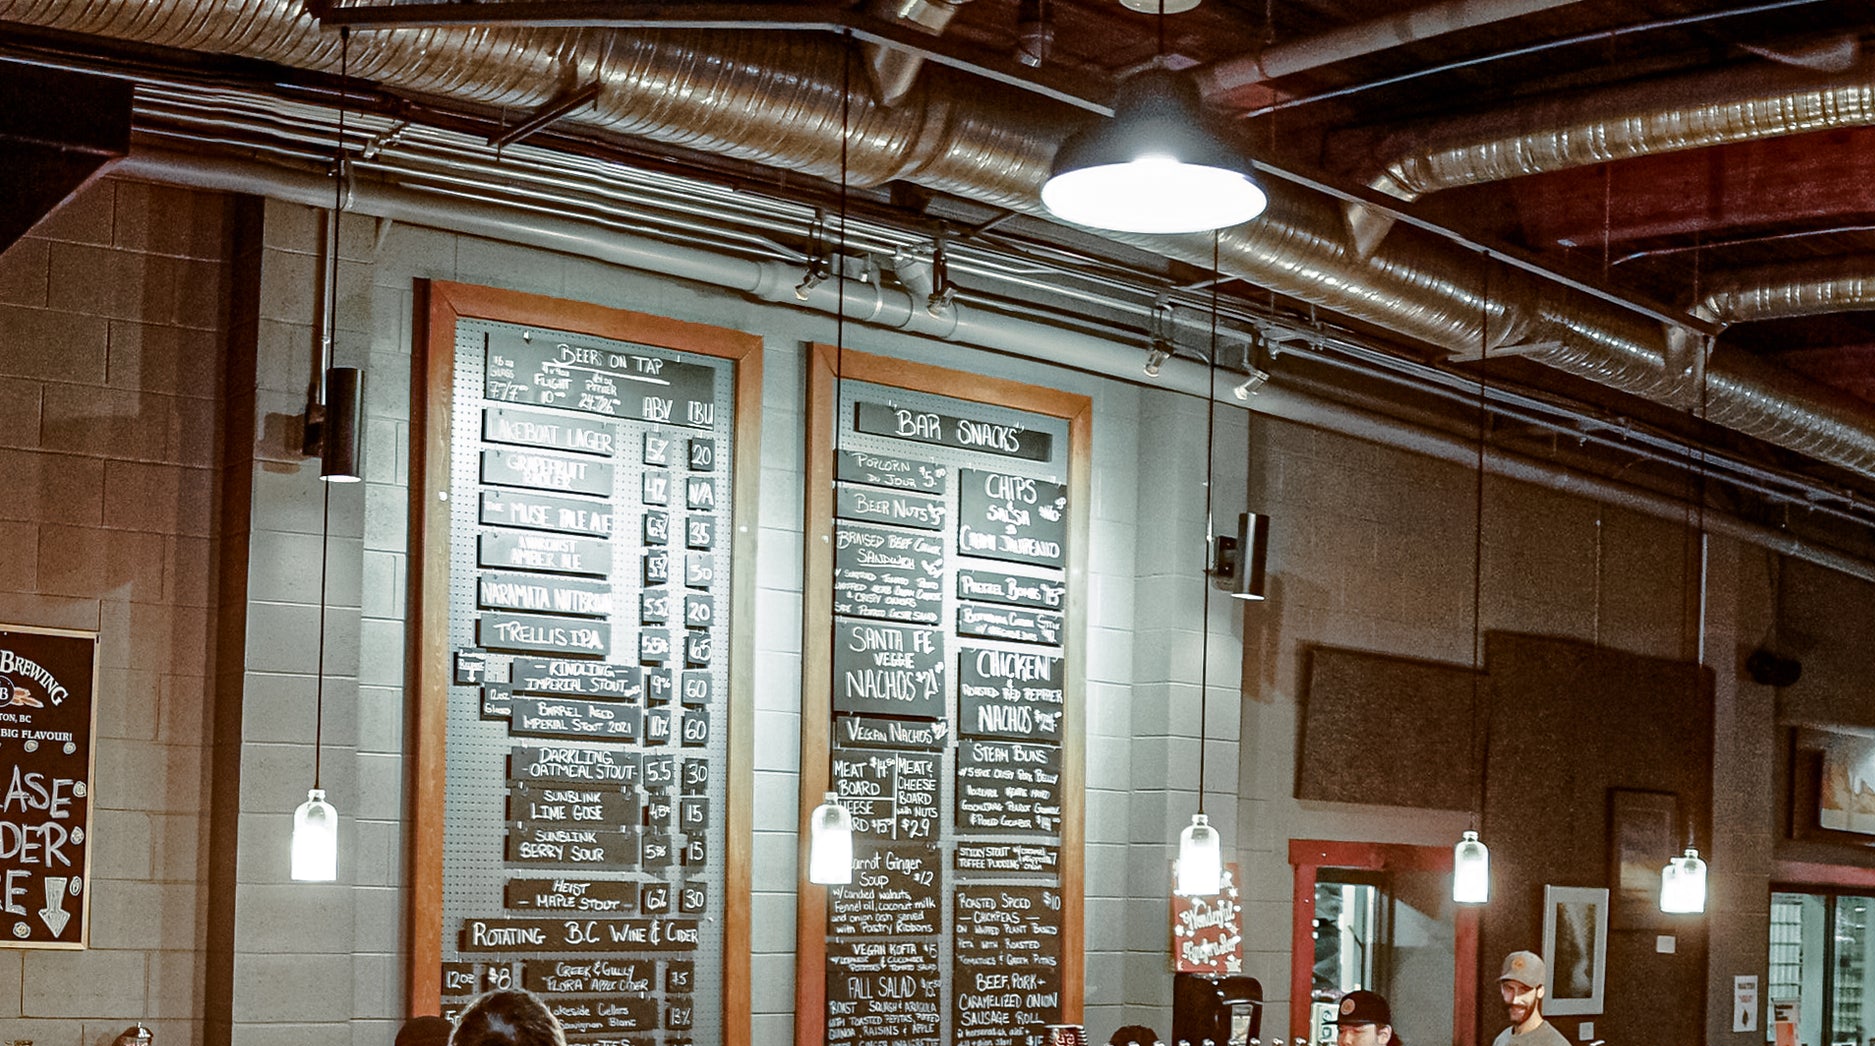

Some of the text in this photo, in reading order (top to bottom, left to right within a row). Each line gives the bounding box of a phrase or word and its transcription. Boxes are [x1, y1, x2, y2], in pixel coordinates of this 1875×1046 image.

[610, 355, 627, 369] ON
[631, 356, 663, 375] TAP
[534, 373, 573, 391] FLIGHT
[642, 397, 674, 421] ABV
[688, 400, 714, 425] IBU
[895, 410, 1019, 452] BAR SNACKS
[567, 428, 614, 453] LAGER
[691, 444, 712, 466] 20
[884, 474, 916, 488] JOUR
[984, 473, 1037, 505] CHIPS
[510, 501, 551, 527] MUSE
[854, 493, 928, 521] BEER NUTS
[688, 602, 711, 622] 20
[493, 621, 711, 661] TRELLIS IPA 65
[850, 626, 935, 654] SANTA FE
[977, 650, 1051, 682] CHICKEN
[0, 649, 69, 706] BREWING
[525, 678, 626, 693] IMPERIAL STOUT
[846, 669, 916, 702] NACHOS
[687, 681, 707, 698] 60
[19, 715, 31, 723] BC
[523, 716, 568, 730] IMPERIAL
[573, 719, 603, 733] STOUT
[537, 703, 583, 718] BARREL
[686, 719, 707, 741] 60
[978, 705, 1032, 735] NACHOS
[1, 728, 72, 741] BIG FLAVOUR!
[847, 717, 933, 744] VEGAN NACHOS
[973, 743, 1048, 764] STEAM BUNS
[539, 747, 614, 765] DARKLING
[686, 764, 708, 784] 30
[834, 760, 867, 778] MEAT
[898, 757, 926, 775] MEAT
[838, 779, 880, 796] BOARD
[898, 776, 936, 791] CHEESE
[543, 790, 703, 822] SUNBLINK 15
[899, 791, 932, 805] BOARD
[531, 803, 604, 821] LIME GOSE
[914, 806, 938, 818] NUTS
[901, 818, 930, 838] $29
[519, 841, 604, 862] BERRY SOUR
[534, 829, 704, 860] SUNBLINK 15
[886, 851, 922, 875] Ginger
[859, 872, 889, 889] Soup
[537, 894, 621, 911] MAPLE STOUT
[552, 880, 590, 894] HEIST
[685, 889, 704, 909] 30
[958, 893, 996, 910] ROASTED
[472, 922, 547, 946] ROTATING
[608, 923, 646, 944] WINE
[665, 922, 699, 945] CIDER
[852, 943, 886, 956] VEGAN
[848, 975, 917, 999] FALL SALAD
[959, 991, 1058, 1011] CARAMELIZED ONION
[961, 1010, 1046, 1026] SAUSAGE ROLL
